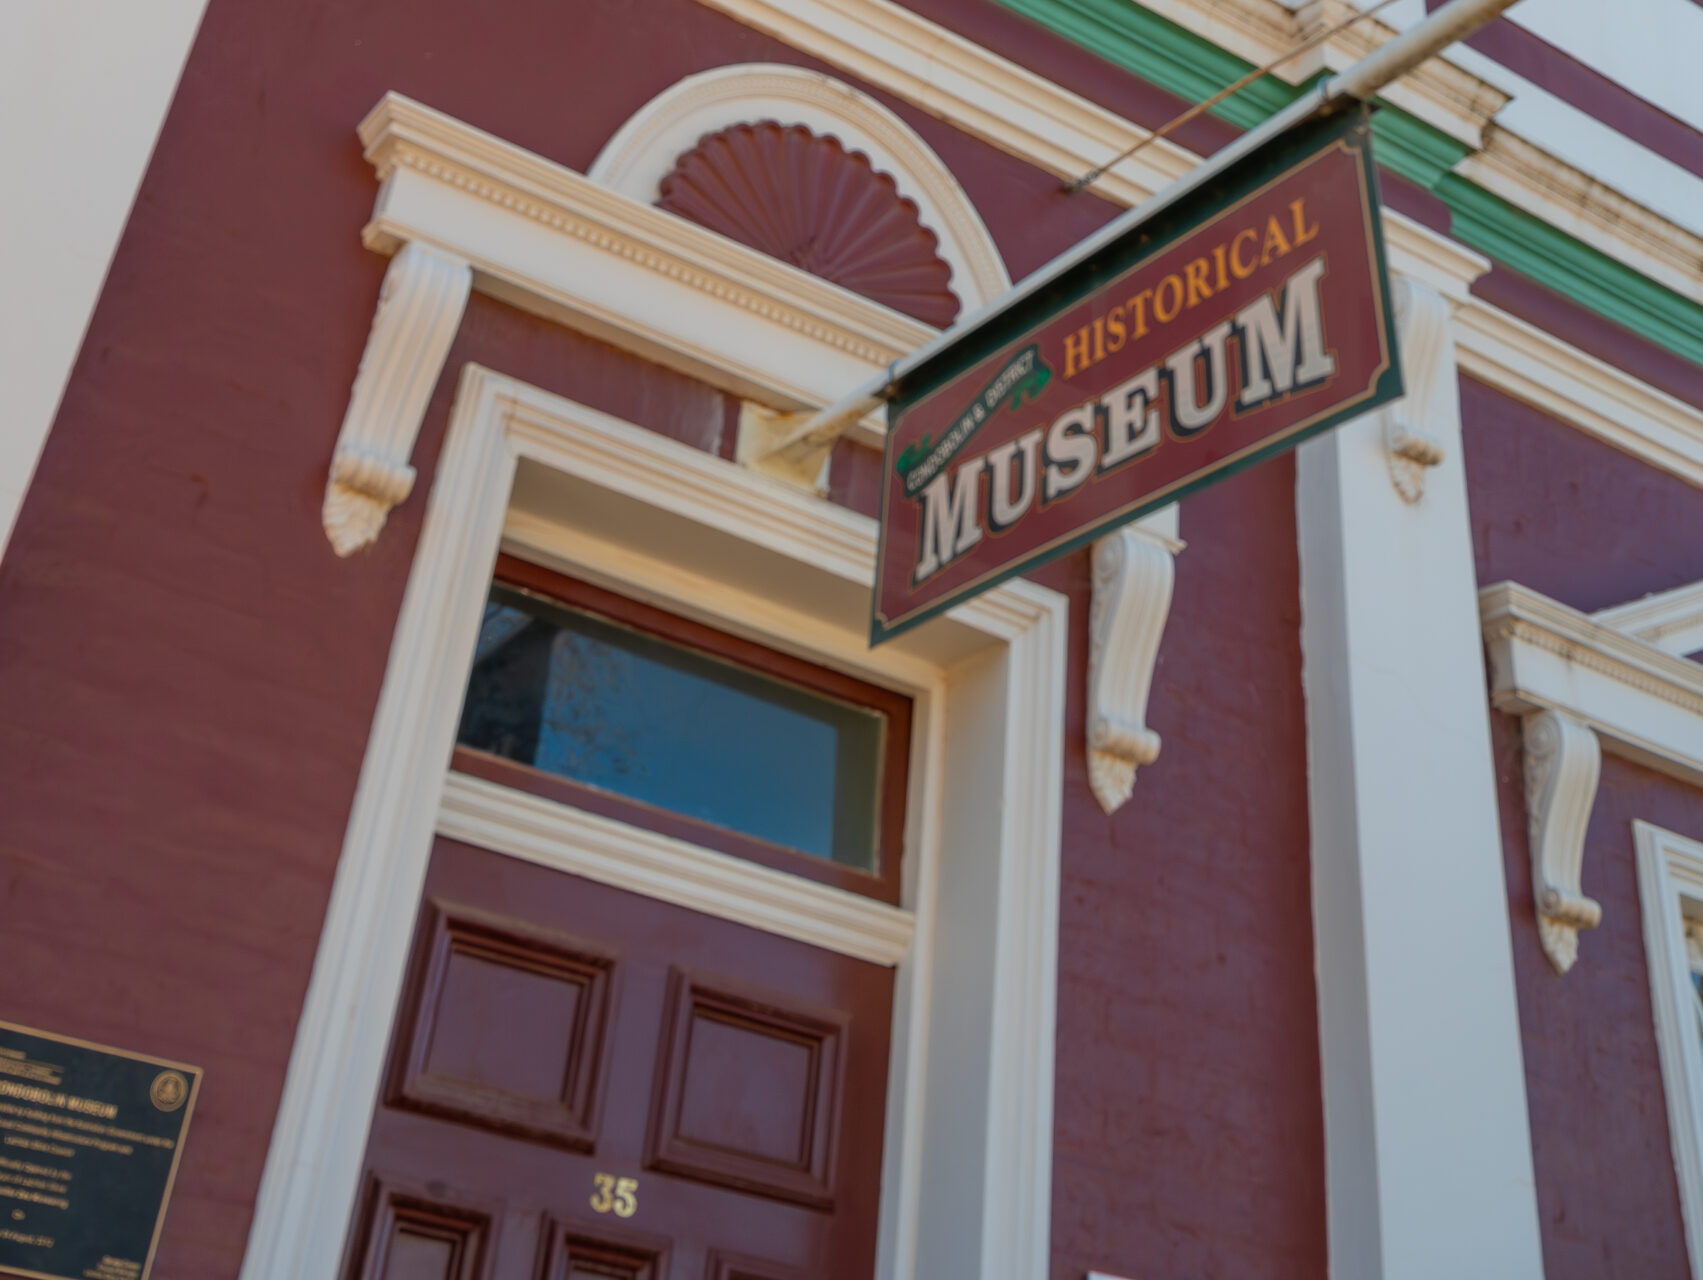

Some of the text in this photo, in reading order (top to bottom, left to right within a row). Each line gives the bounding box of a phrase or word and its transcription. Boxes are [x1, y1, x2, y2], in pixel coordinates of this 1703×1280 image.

[1063, 198, 1320, 379] HISTORICAL
[914, 256, 1337, 584] MUSEUM
[589, 1172, 639, 1218] 35
